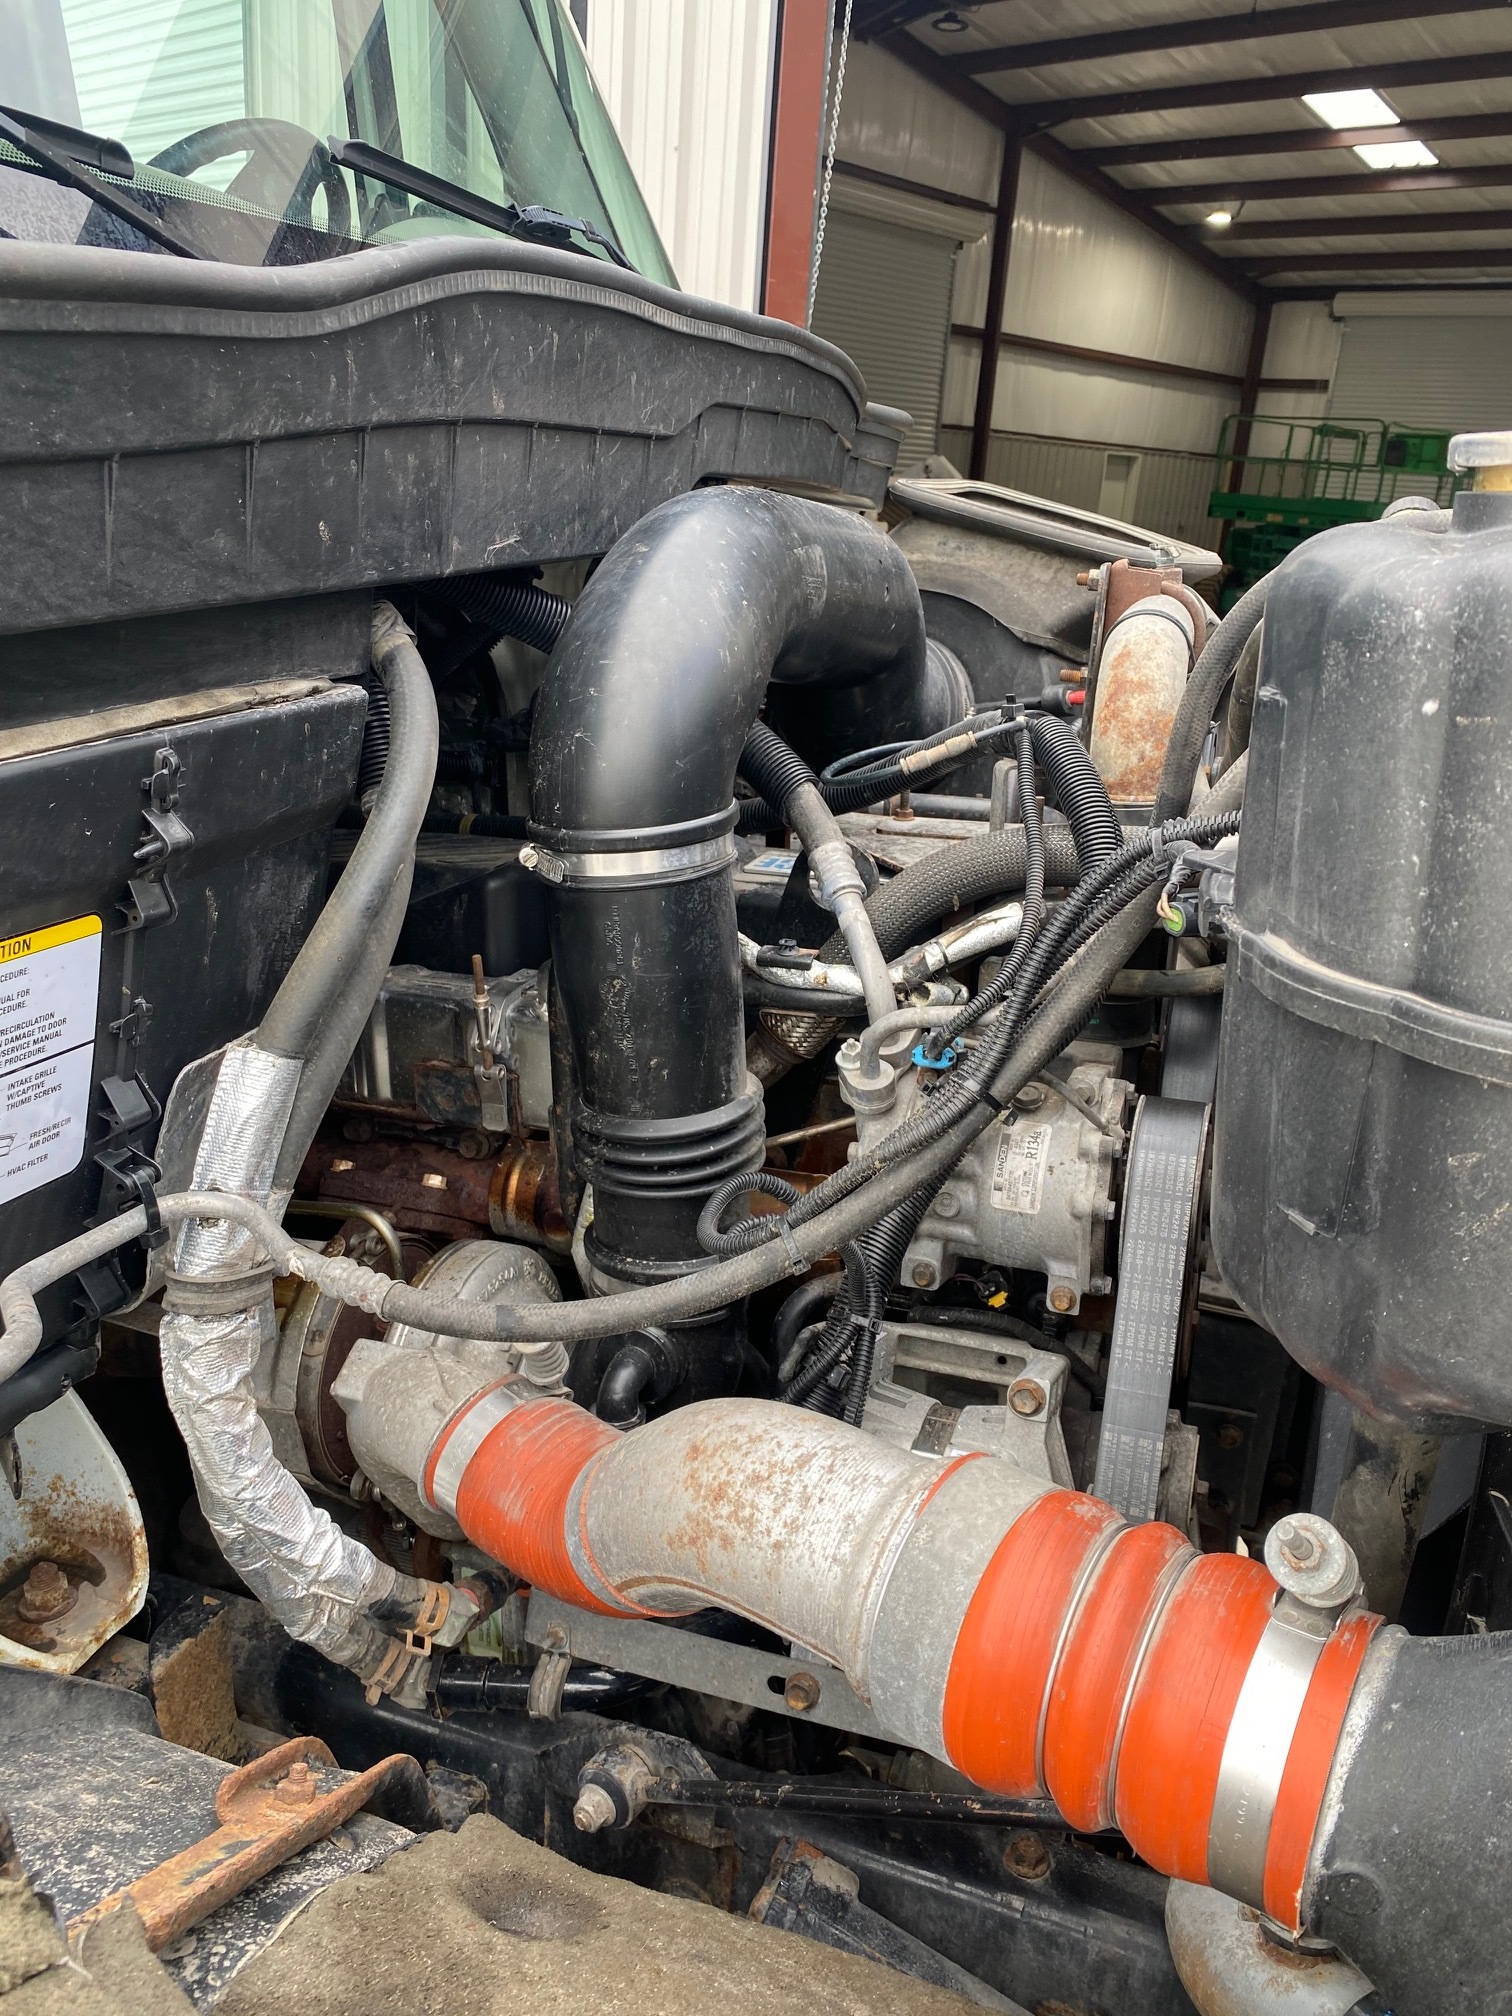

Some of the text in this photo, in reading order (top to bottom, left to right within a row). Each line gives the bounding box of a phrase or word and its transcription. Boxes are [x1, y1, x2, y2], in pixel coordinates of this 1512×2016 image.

[17, 989, 30, 999] FOR
[5, 1028, 36, 1046] DAMAGE
[38, 1025, 46, 1034] TO
[48, 1017, 67, 1031] DOOR
[33, 1029, 63, 1046] MANUAL
[7, 1080, 45, 1102] W/CAPTIVE
[8, 1066, 57, 1091] INTAKE GRILLE
[6, 1083, 62, 1112] THUMB SCREWS
[29, 1131, 60, 1150] AIR DOOR
[1026, 1131, 1041, 1160] R134a
[7, 1153, 48, 1177] HVAC FILTER
[997, 1145, 1008, 1178] SANDEN
[1171, 1201, 1182, 1239] 10PK2475
